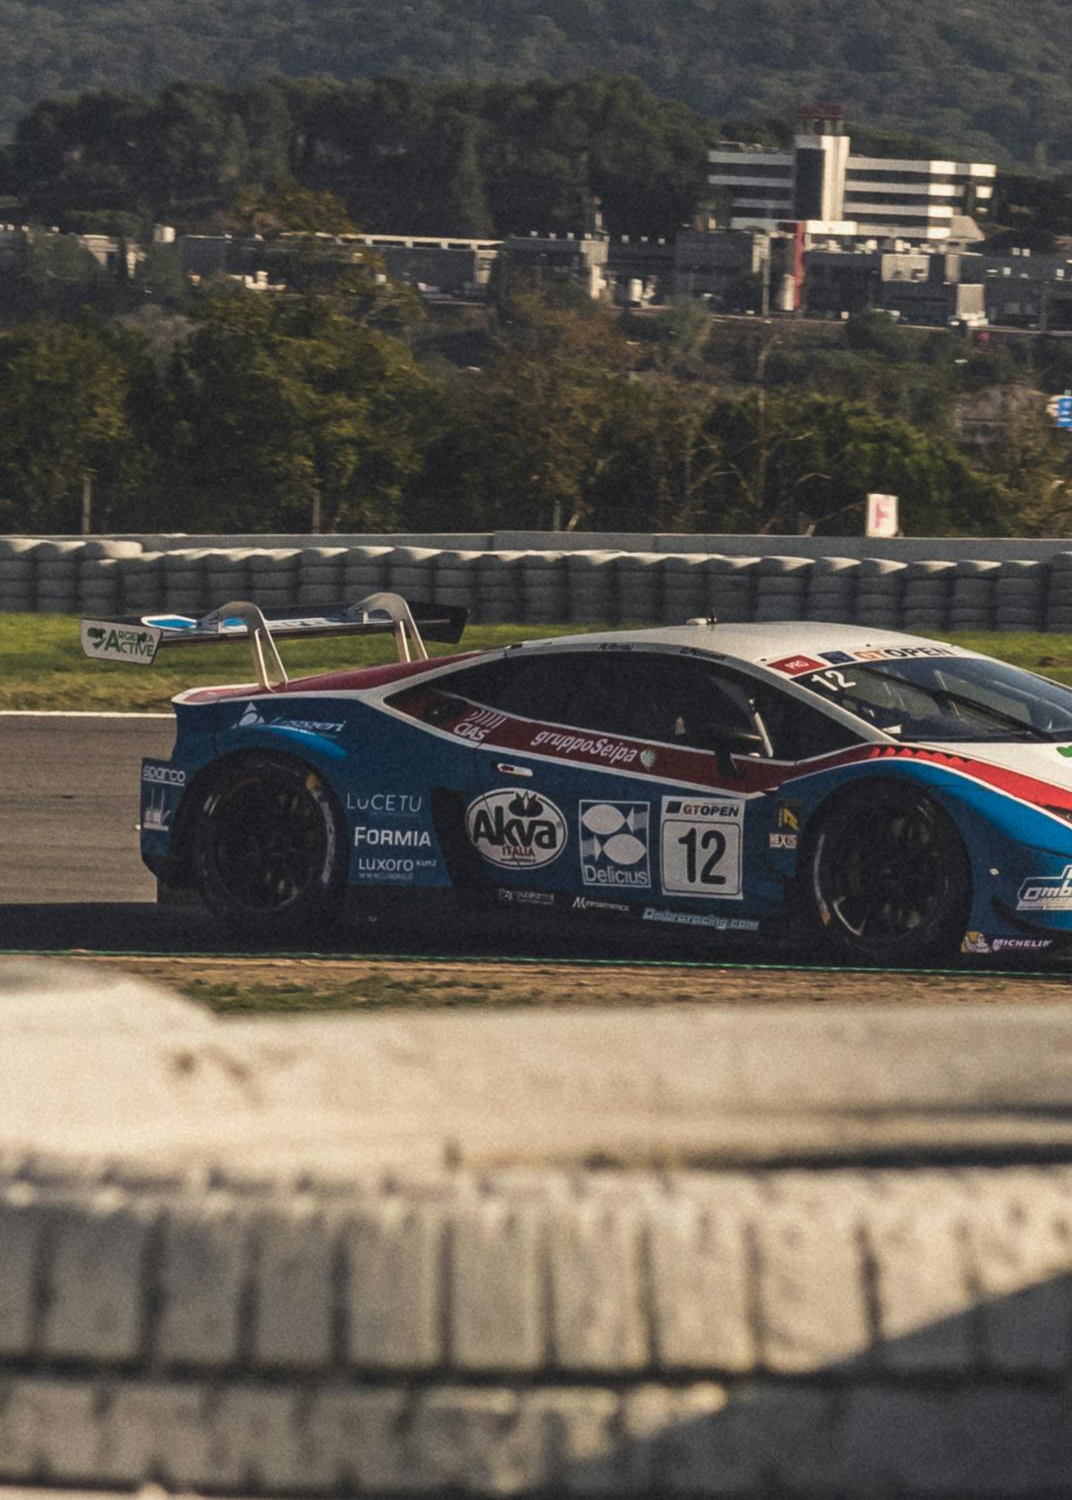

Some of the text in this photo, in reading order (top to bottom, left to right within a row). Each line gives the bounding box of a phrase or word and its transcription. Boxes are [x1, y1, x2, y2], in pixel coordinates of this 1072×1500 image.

[811, 670, 856, 692] 12
[453, 723, 490, 741] CIAS
[143, 765, 186, 784] sparco
[354, 826, 432, 847] FORMIA
[473, 806, 557, 850] Akva
[678, 827, 726, 885] 12
[585, 864, 649, 885] Delicius
